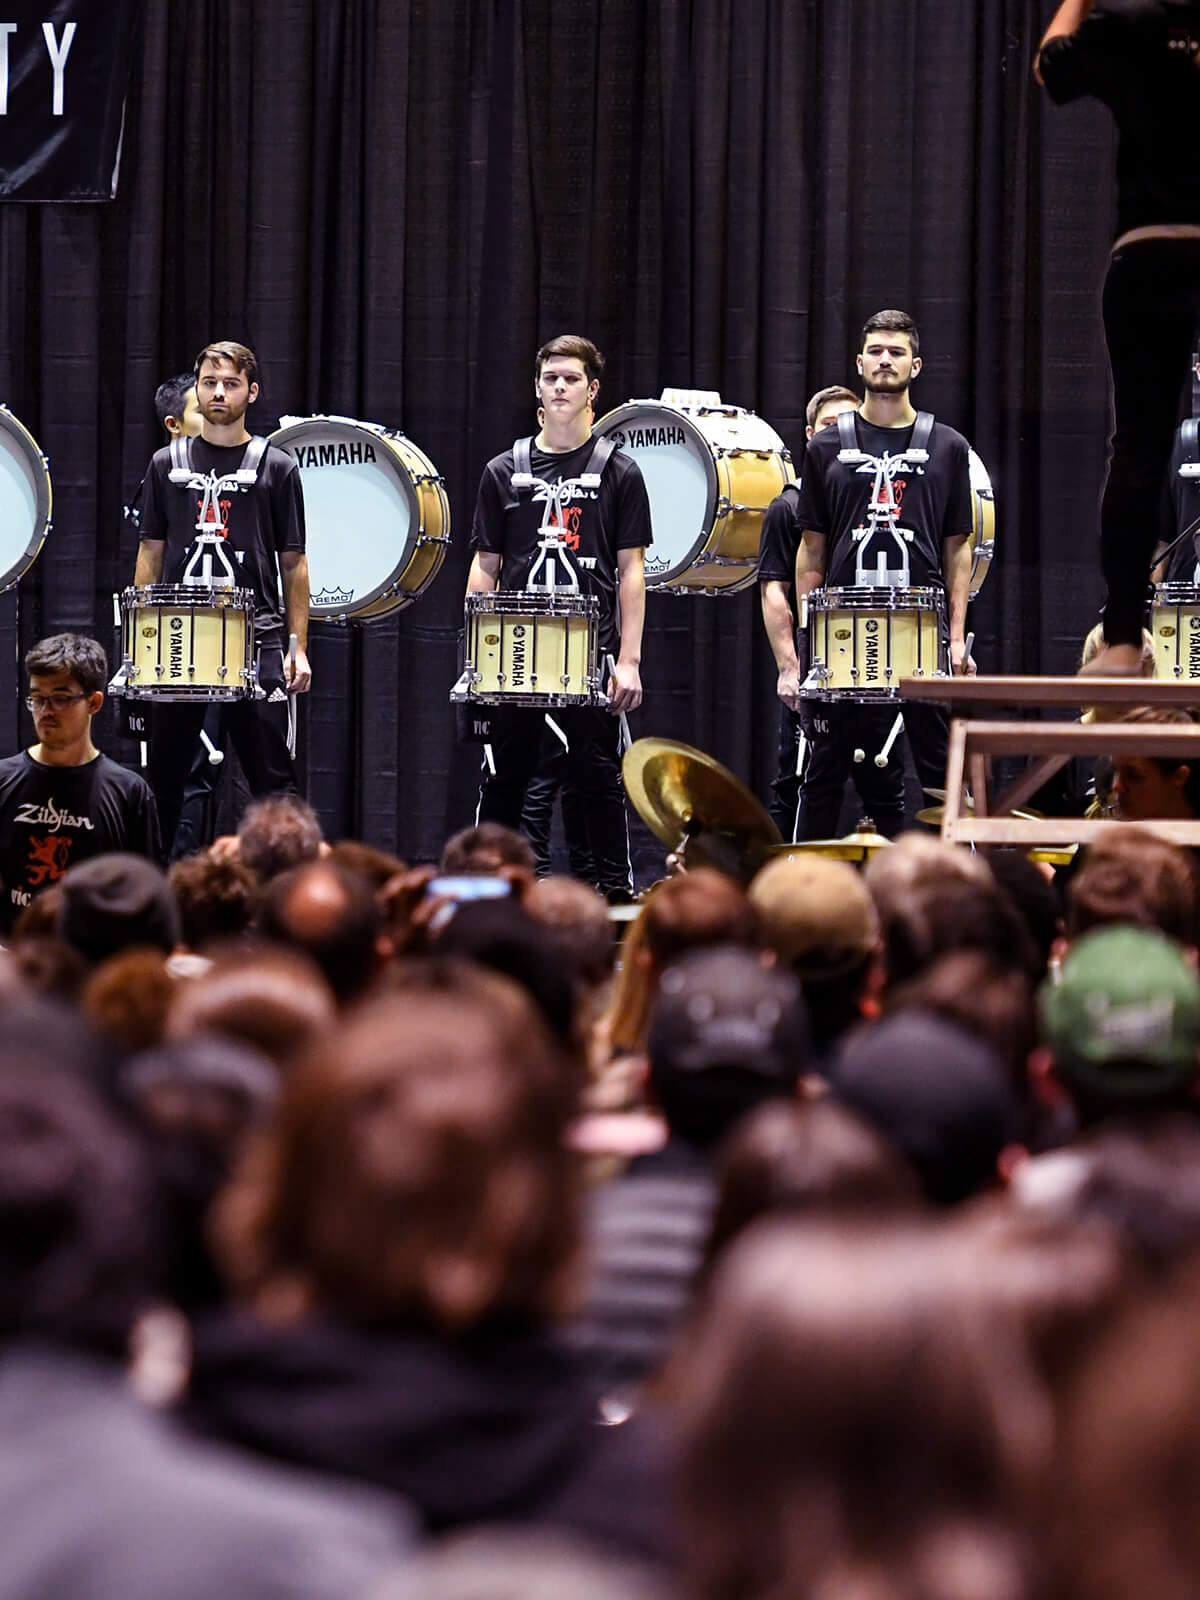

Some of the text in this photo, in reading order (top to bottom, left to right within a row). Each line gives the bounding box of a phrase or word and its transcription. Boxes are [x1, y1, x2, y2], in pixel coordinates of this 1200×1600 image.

[293, 441, 377, 469] YAMAHA
[627, 426, 687, 449] YAMAHA
[315, 595, 349, 603] REMO
[169, 631, 183, 679] YAMAHA
[512, 639, 526, 687] YAMAHA
[865, 634, 879, 682] YAMAHA
[1189, 631, 1200, 678] YAMAHA
[13, 797, 95, 833] Zildjian
